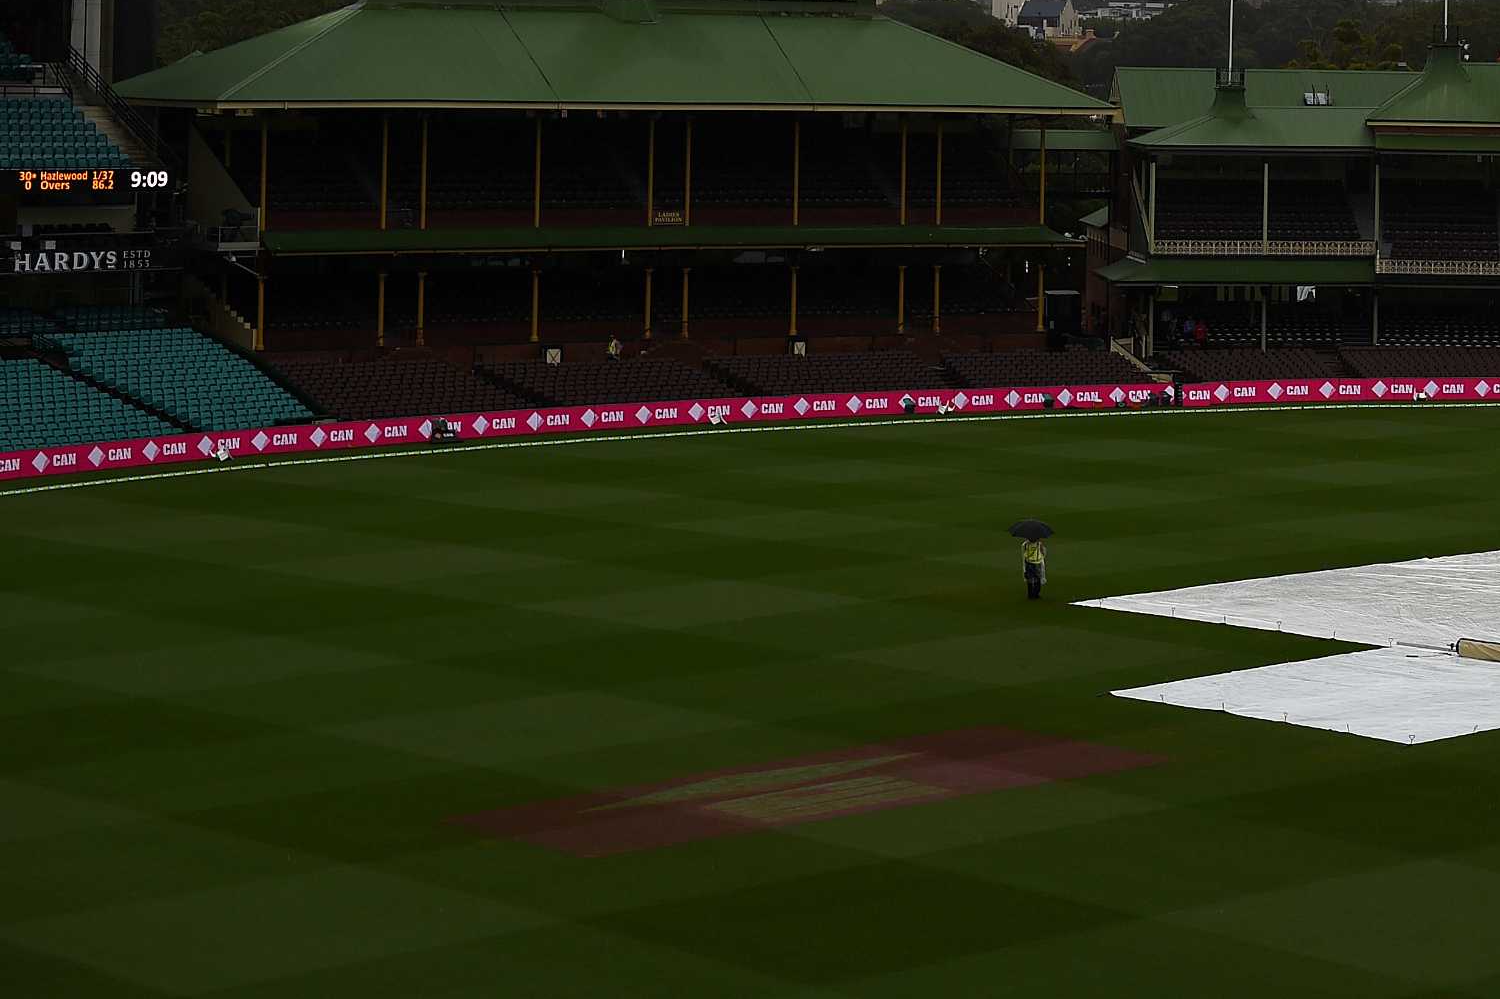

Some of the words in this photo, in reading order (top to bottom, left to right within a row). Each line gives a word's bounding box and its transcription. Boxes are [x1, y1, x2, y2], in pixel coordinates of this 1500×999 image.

[40, 171, 88, 181] Hazlewood
[92, 171, 114, 180] 1/37
[131, 171, 168, 188] 9:09
[25, 181, 32, 190] 0
[40, 181, 70, 190] Overs
[92, 181, 114, 190] 86.2
[123, 250, 151, 258] ESTD
[14, 251, 118, 272] HARDYS
[54, 454, 77, 466] CAN
[110, 448, 132, 460] CAN
[164, 443, 187, 455] CAN
[274, 434, 298, 445] CAN
[332, 430, 354, 441] CAN
[386, 426, 408, 437] CAN
[494, 418, 516, 429] CAN
[548, 415, 570, 425] CAN
[603, 411, 624, 422] CAN
[657, 408, 678, 419] CAN
[763, 404, 784, 413] CAN
[814, 401, 836, 410] CAN
[867, 399, 888, 408] CAN
[918, 397, 941, 407] CAN
[973, 395, 994, 405] CAN
[1078, 392, 1099, 402] CAN
[1190, 391, 1211, 400] CAN
[1234, 388, 1256, 397] CAN
[1288, 386, 1309, 395] CAN
[1340, 385, 1361, 394] CAN
[1391, 384, 1412, 393] CAN
[1444, 385, 1464, 393] CAN
